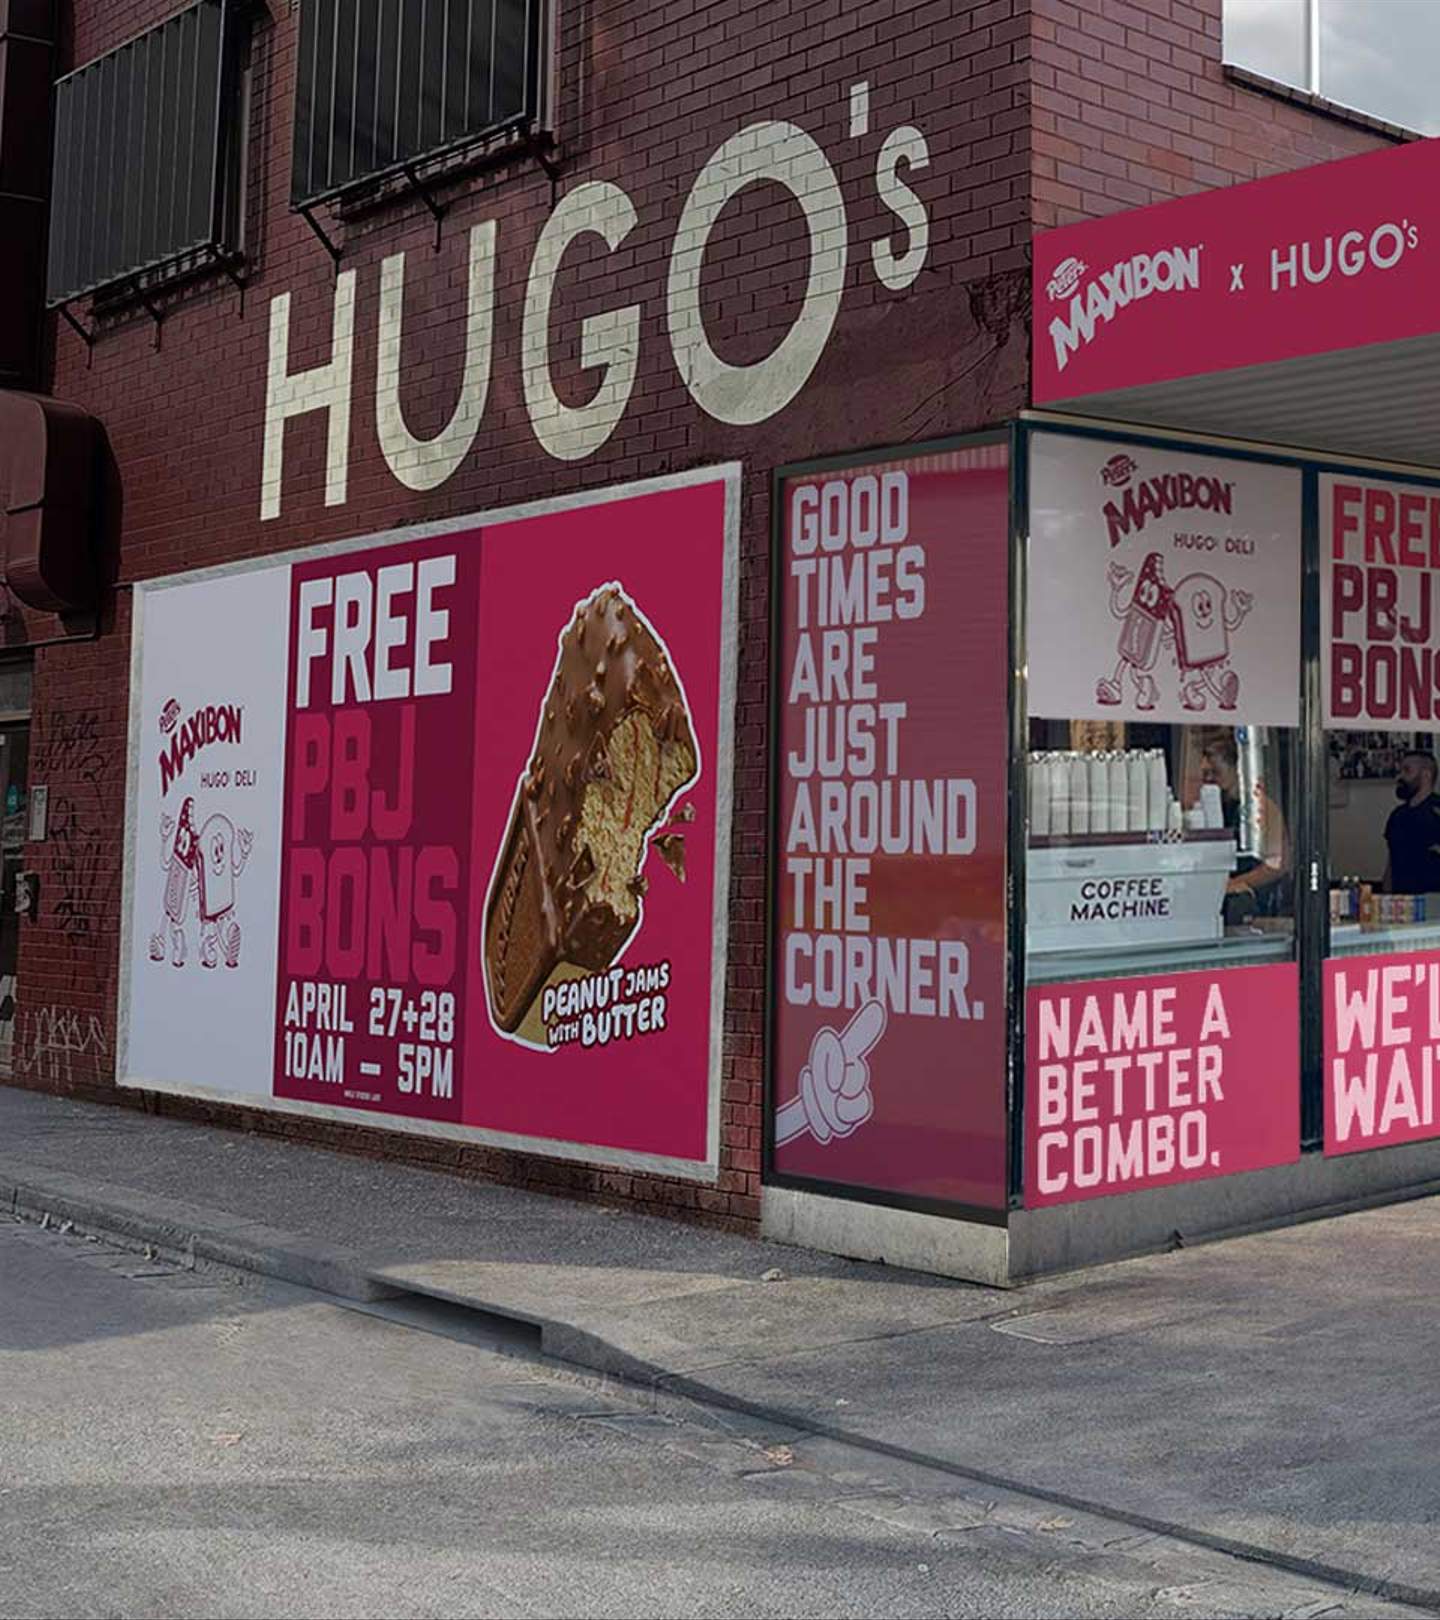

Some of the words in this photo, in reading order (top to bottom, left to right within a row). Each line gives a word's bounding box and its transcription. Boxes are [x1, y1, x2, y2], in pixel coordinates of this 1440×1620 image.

[1048, 246, 1199, 372] MAXIBON
[792, 469, 910, 555] GOOD
[1103, 473, 1232, 548] MAXIBON
[1225, 537, 1255, 554] DELI
[791, 543, 926, 628] TIMES
[1332, 563, 1431, 645] PBJ
[295, 555, 457, 708] FREE
[788, 627, 878, 703] ARE
[159, 705, 241, 797] MAXIBON
[291, 704, 416, 842] PBJ
[788, 702, 907, 778] JUST
[235, 770, 256, 787] DELI
[786, 778, 977, 855] AROUND
[285, 845, 459, 986] BONS
[787, 857, 870, 933] THE
[1071, 897, 1171, 920] MACHINE
[1081, 878, 1162, 900] COFFEE
[284, 980, 354, 1033] APRIL
[369, 986, 455, 1043] 27+28
[543, 967, 624, 1022] PEANUT
[625, 962, 669, 997] JAMS
[785, 934, 985, 1020] CORNER.
[549, 1020, 579, 1045] WITH
[581, 995, 666, 1046] BUTTER
[1038, 987, 1177, 1060] NAME
[1200, 983, 1230, 1042] A
[284, 1030, 344, 1084] 10AM
[398, 1042, 453, 1099] 5PM
[1038, 1044, 1225, 1128] BETTER
